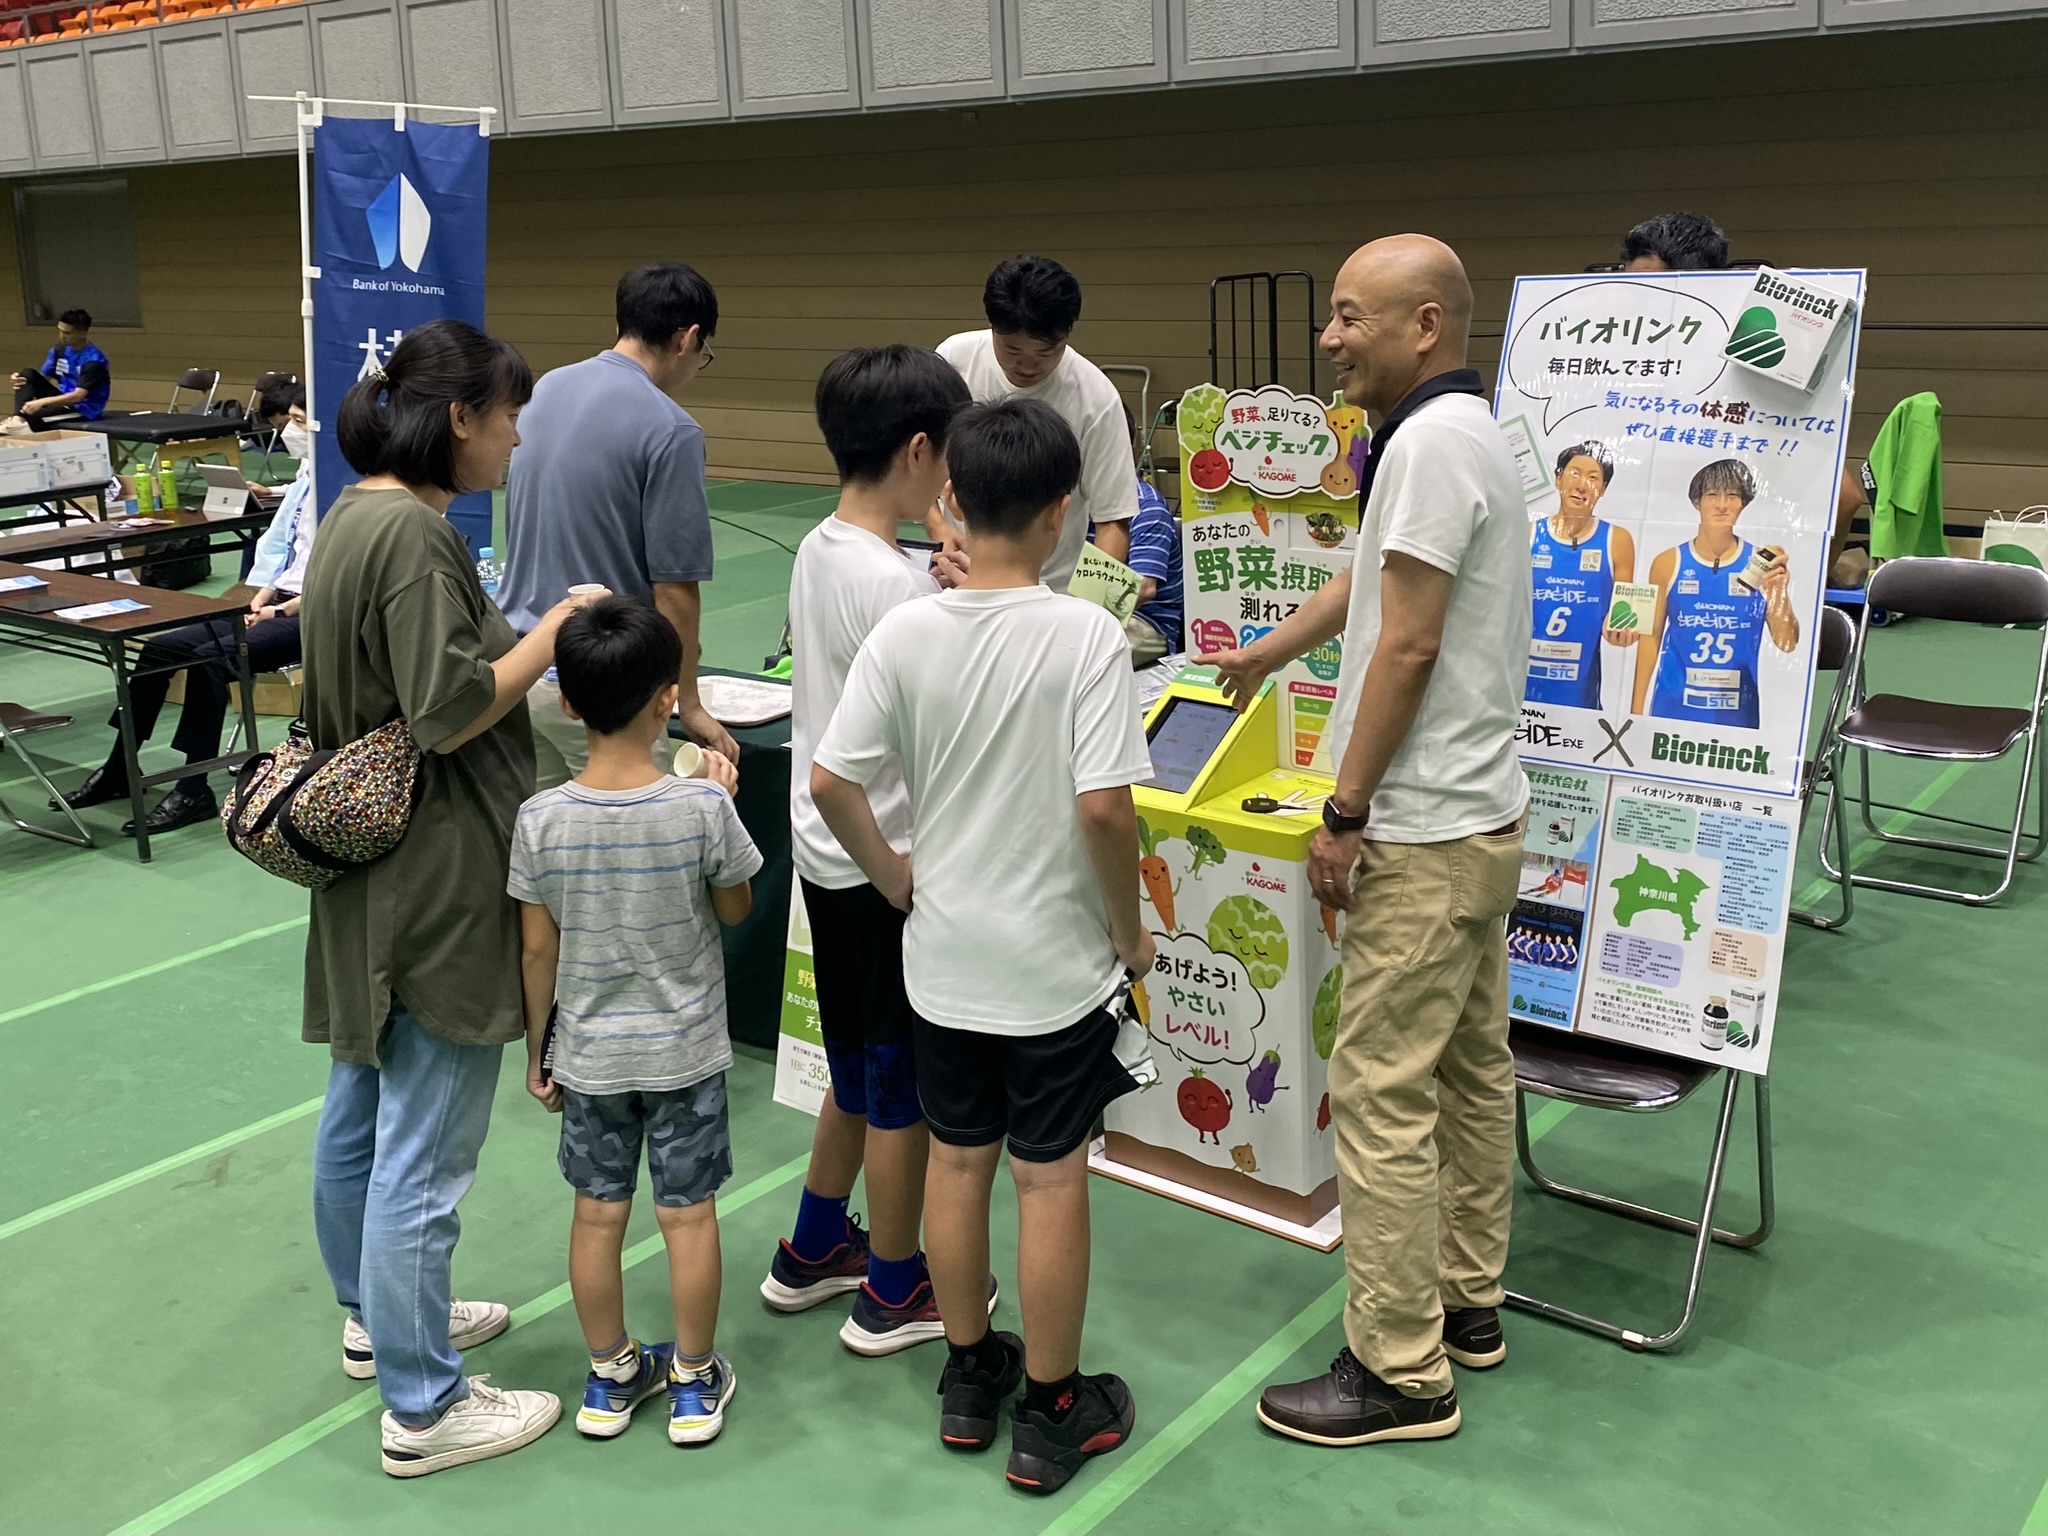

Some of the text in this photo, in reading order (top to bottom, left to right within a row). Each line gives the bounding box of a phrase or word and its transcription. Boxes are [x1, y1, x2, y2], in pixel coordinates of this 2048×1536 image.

[352, 278, 445, 296] Bank of Yokohama
[1753, 272, 1839, 320] Biorinck
[1539, 315, 1702, 345] バイオリンク
[1547, 357, 1682, 377] 毎日飲んでます!
[1231, 405, 1320, 429] 野菜、足りてる?
[1604, 390, 1836, 434] 気になるその体感については
[1221, 429, 1329, 455] ベジチェック
[1258, 471, 1297, 482] KAGOME
[1192, 522, 1250, 542] あなたの
[1615, 585, 1656, 598] Biorinck
[1545, 606, 1572, 637] 6
[1194, 622, 1202, 644] 1
[1312, 647, 1340, 663] 30秒
[1690, 632, 1736, 664] 35
[1549, 668, 1575, 679] STC
[1709, 697, 1735, 707] STC
[1651, 732, 1771, 775] Biorinck
[1632, 785, 1774, 817] バイオリンクお取り扱い店 一覧
[1246, 877, 1287, 893] KAGOME
[1639, 886, 1678, 903] 神奈川県
[1516, 901, 1536, 911] EART
[1155, 953, 1237, 992] あげよう!
[1167, 985, 1225, 1016] やさい
[1530, 1003, 1568, 1022] Biorinck
[1166, 1014, 1229, 1050] レベル!
